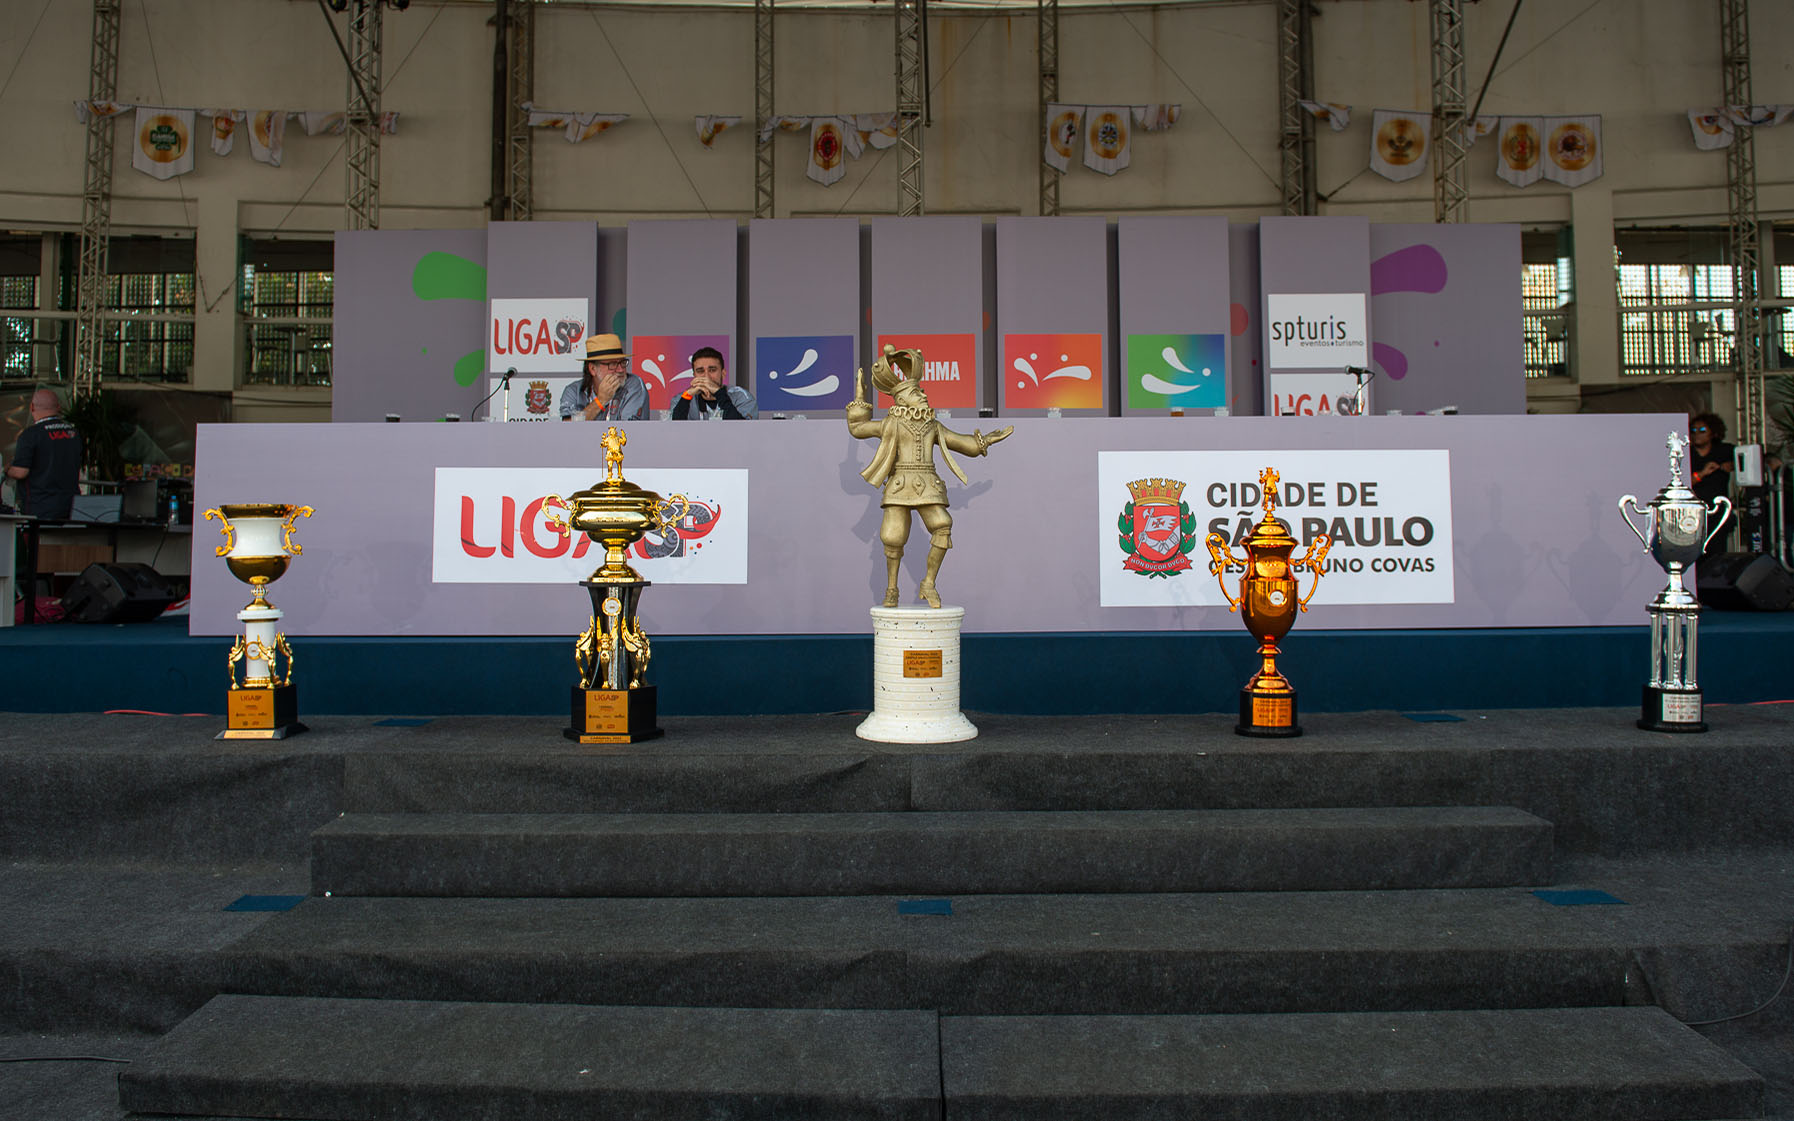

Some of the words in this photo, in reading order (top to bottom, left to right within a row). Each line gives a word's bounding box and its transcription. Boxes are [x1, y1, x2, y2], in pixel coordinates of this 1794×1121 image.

[1272, 315, 1346, 347] spturis
[1336, 482, 1379, 507] DE
[1301, 516, 1434, 547] PAULO
[1370, 557, 1436, 573] COVAS
